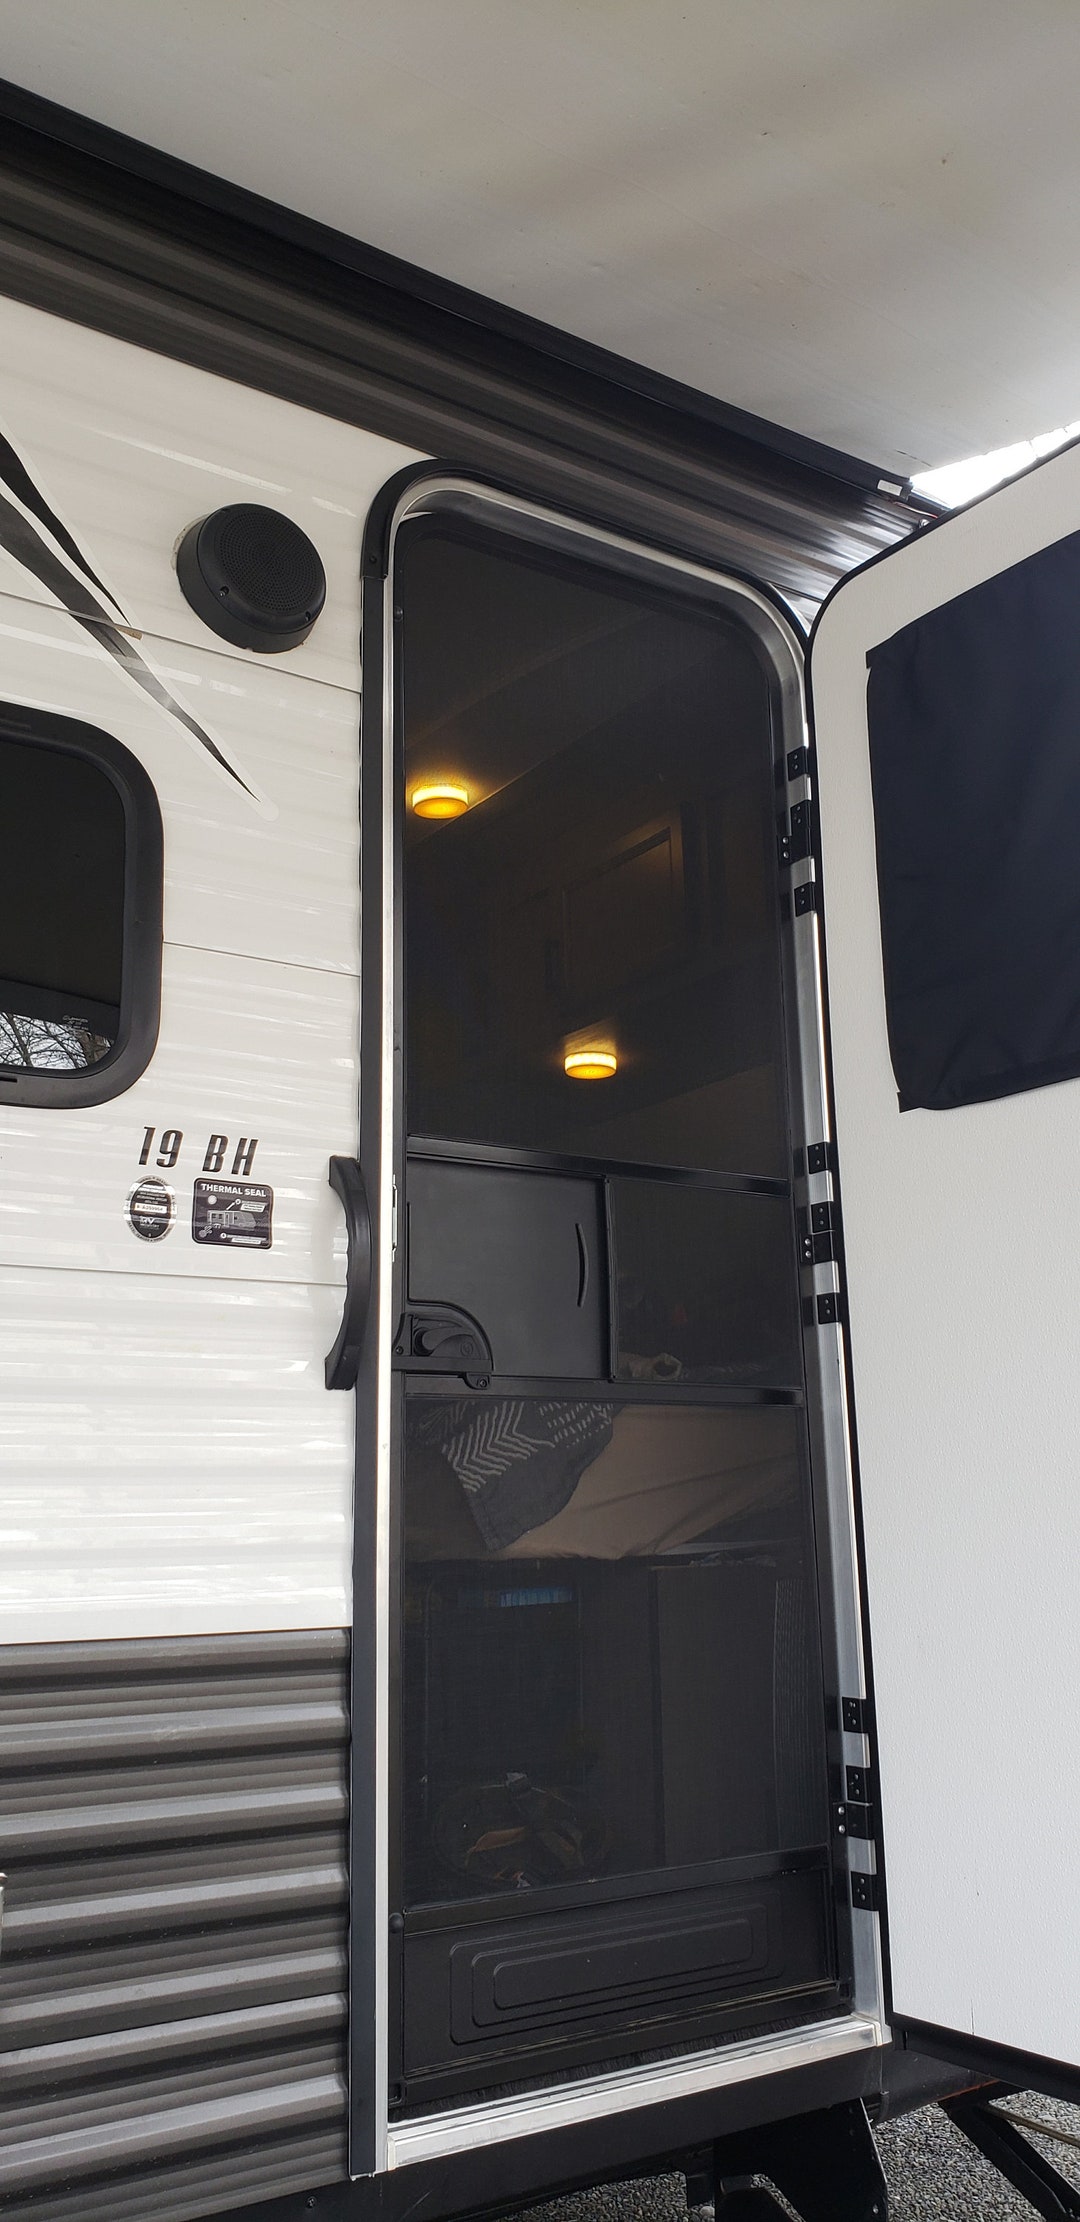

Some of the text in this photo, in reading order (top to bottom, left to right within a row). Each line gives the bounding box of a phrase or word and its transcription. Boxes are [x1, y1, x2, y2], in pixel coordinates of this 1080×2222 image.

[138, 1126, 259, 1176] 19 BH
[201, 1183, 267, 1197] THERMAL SEAL
